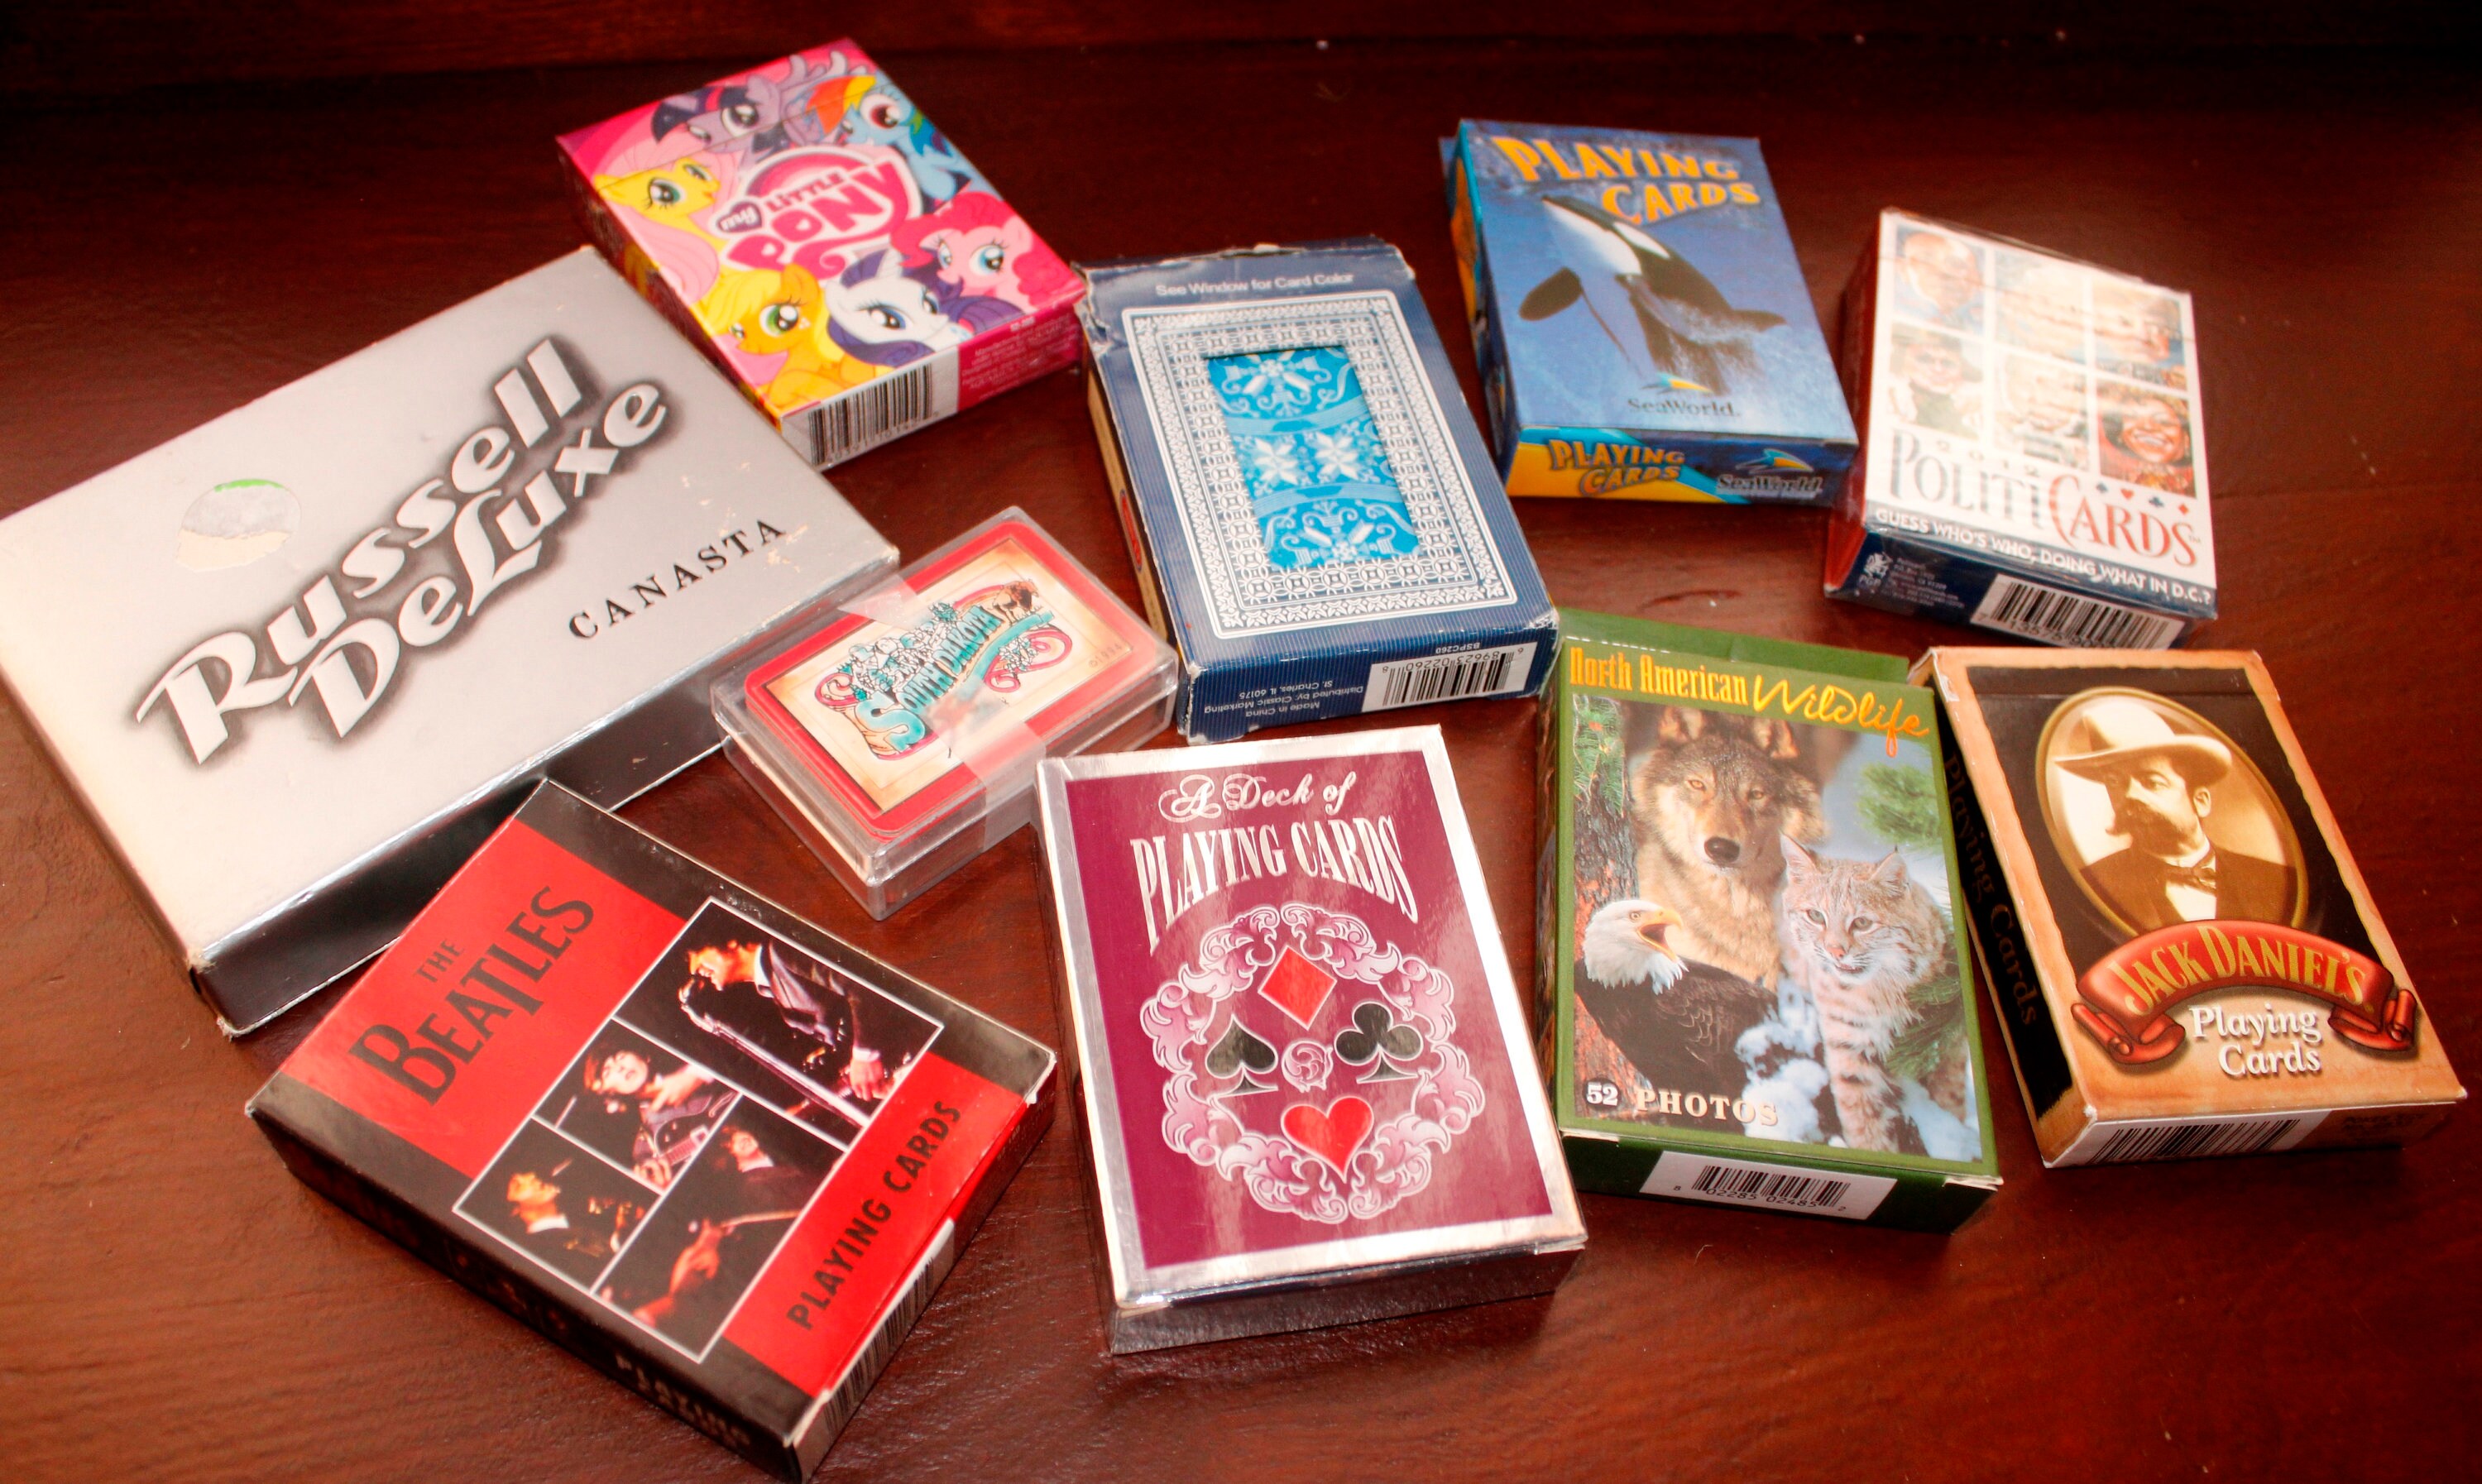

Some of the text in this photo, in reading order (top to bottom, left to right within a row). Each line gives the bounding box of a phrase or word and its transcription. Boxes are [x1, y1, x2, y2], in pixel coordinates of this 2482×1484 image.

[1492, 136, 1740, 183] PLAYING
[720, 206, 759, 232] my
[726, 161, 909, 280] PONY
[1602, 182, 1761, 226] CARDS
[1156, 271, 1354, 296] See Window for Card Color
[1549, 438, 1686, 471] PLAYING
[1579, 465, 1682, 496] CARDS
[1717, 473, 1824, 496] SeaWorld
[136, 338, 582, 764] Russell
[287, 384, 665, 738] DeLuxe
[1875, 508, 2212, 606] GUESS WHO'S WHO, DOING WHAT IN D.C.?
[568, 519, 787, 639] CANASTA
[1406, 658, 1449, 672] 02260
[1435, 642, 1481, 654] BSPC260
[1457, 651, 1499, 663] 89623
[855, 605, 1005, 753] SOUTH DAKOTA
[1239, 688, 1266, 700] 60175
[1279, 681, 1320, 694] Charles,
[1312, 686, 1363, 699] Distributed
[1204, 701, 1254, 714] Marketing
[1245, 701, 1320, 717] Made in China
[1257, 696, 1292, 706] Classic
[1640, 653, 1749, 706] American
[1752, 674, 1930, 758] Wildlife
[1158, 771, 1357, 823] A Deck of
[1130, 814, 1419, 957] PLAYING CARDS
[1943, 751, 2038, 1026] Playing Cards
[414, 939, 465, 984] THE
[2106, 924, 2366, 1017] JACK DANIEL'S
[347, 885, 595, 1107] BEATLES
[2188, 1003, 2323, 1046] Playing
[2218, 1041, 2322, 1076] Cards
[1585, 1080, 1780, 1127] 52 PHOTOS
[786, 1099, 961, 1331] PLAYING CARDS
[1705, 1188, 1757, 1201] 02285
[1766, 1195, 1818, 1209] 02485
